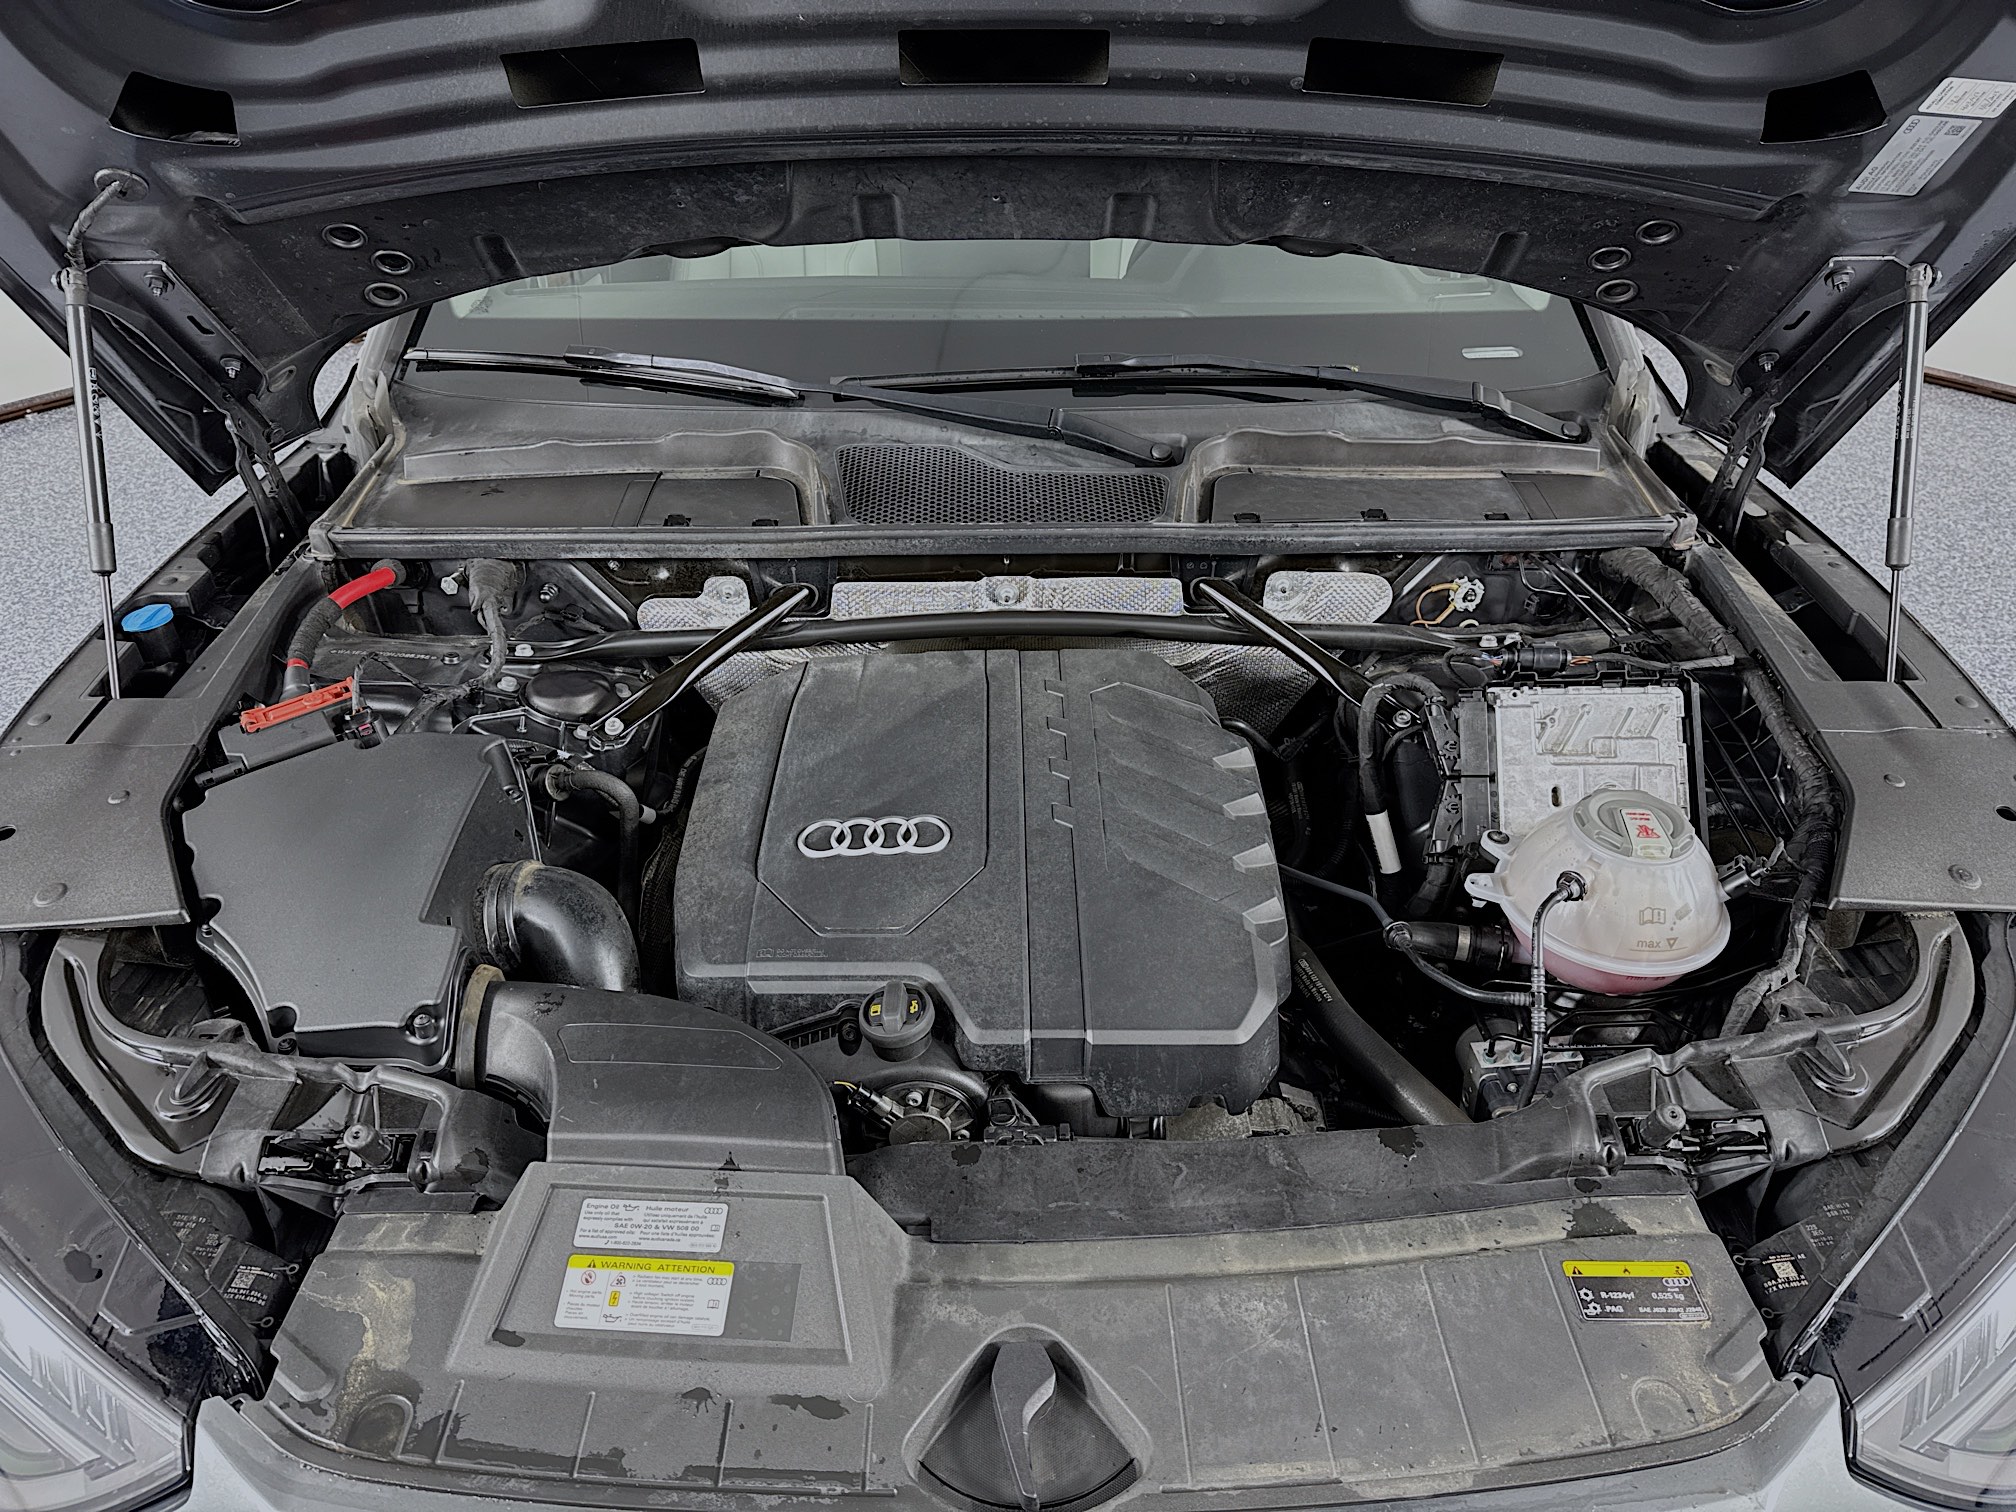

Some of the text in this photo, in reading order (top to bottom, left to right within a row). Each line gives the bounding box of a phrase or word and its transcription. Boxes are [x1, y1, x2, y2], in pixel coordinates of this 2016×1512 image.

[1636, 940, 1661, 948] max
[601, 1261, 715, 1274] WARNING ATTENTION
[1674, 1292, 1684, 1300] kg
